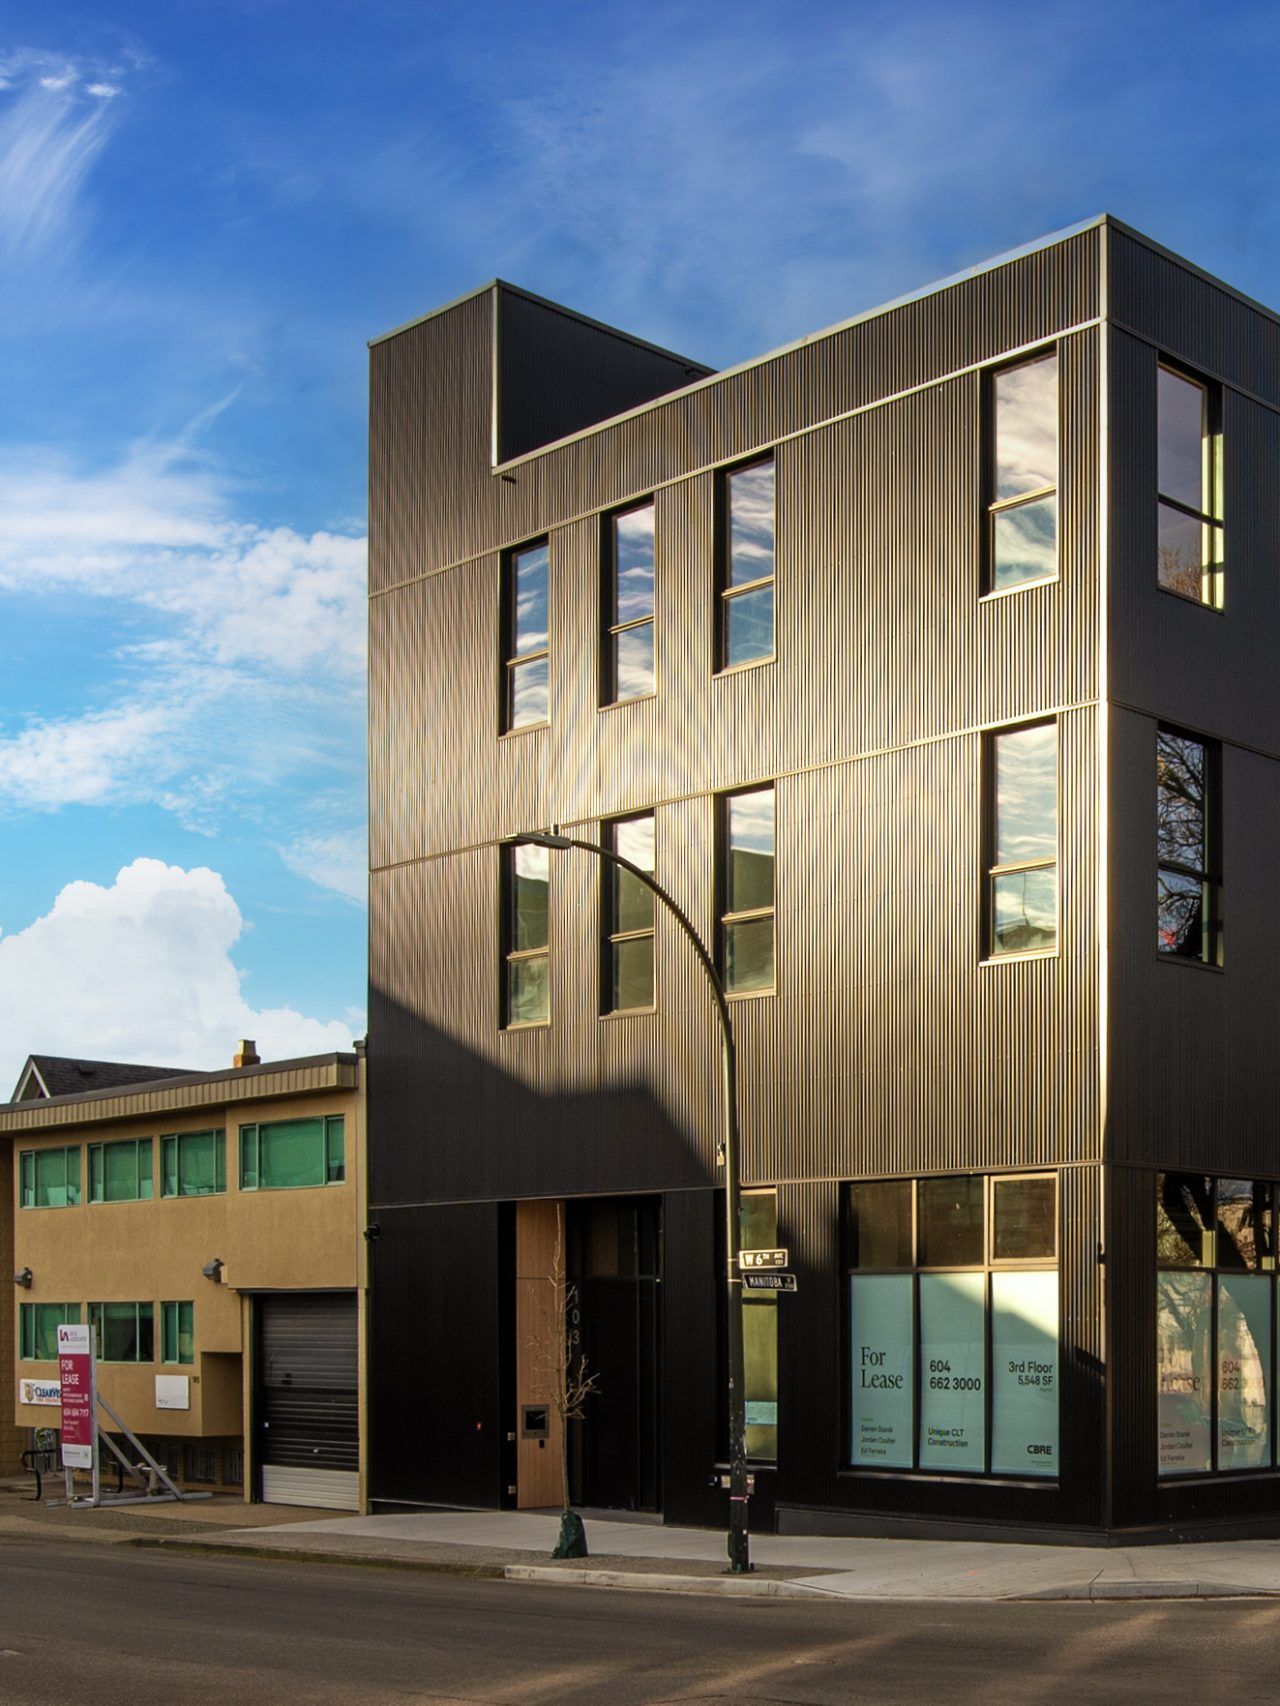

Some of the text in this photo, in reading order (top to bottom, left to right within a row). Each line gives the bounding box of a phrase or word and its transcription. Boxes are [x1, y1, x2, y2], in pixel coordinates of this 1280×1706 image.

[745, 1253, 754, 1266] W
[749, 1275, 783, 1288] MANITOBA
[860, 1346, 887, 1366] For
[61, 1359, 73, 1371] FOR
[929, 1360, 951, 1373] 604
[1008, 1361, 1053, 1374] 3rd Floor
[1222, 1361, 1241, 1374] 604
[61, 1373, 80, 1385] LEASE
[860, 1369, 904, 1390] Lease
[929, 1377, 981, 1391] 662 3000
[1018, 1375, 1053, 1386] 5,548 SF
[1222, 1378, 1240, 1390] 662
[928, 1427, 964, 1438] Unique CLT
[927, 1438, 968, 1448] Construction
[1027, 1444, 1052, 1455] CBRE
